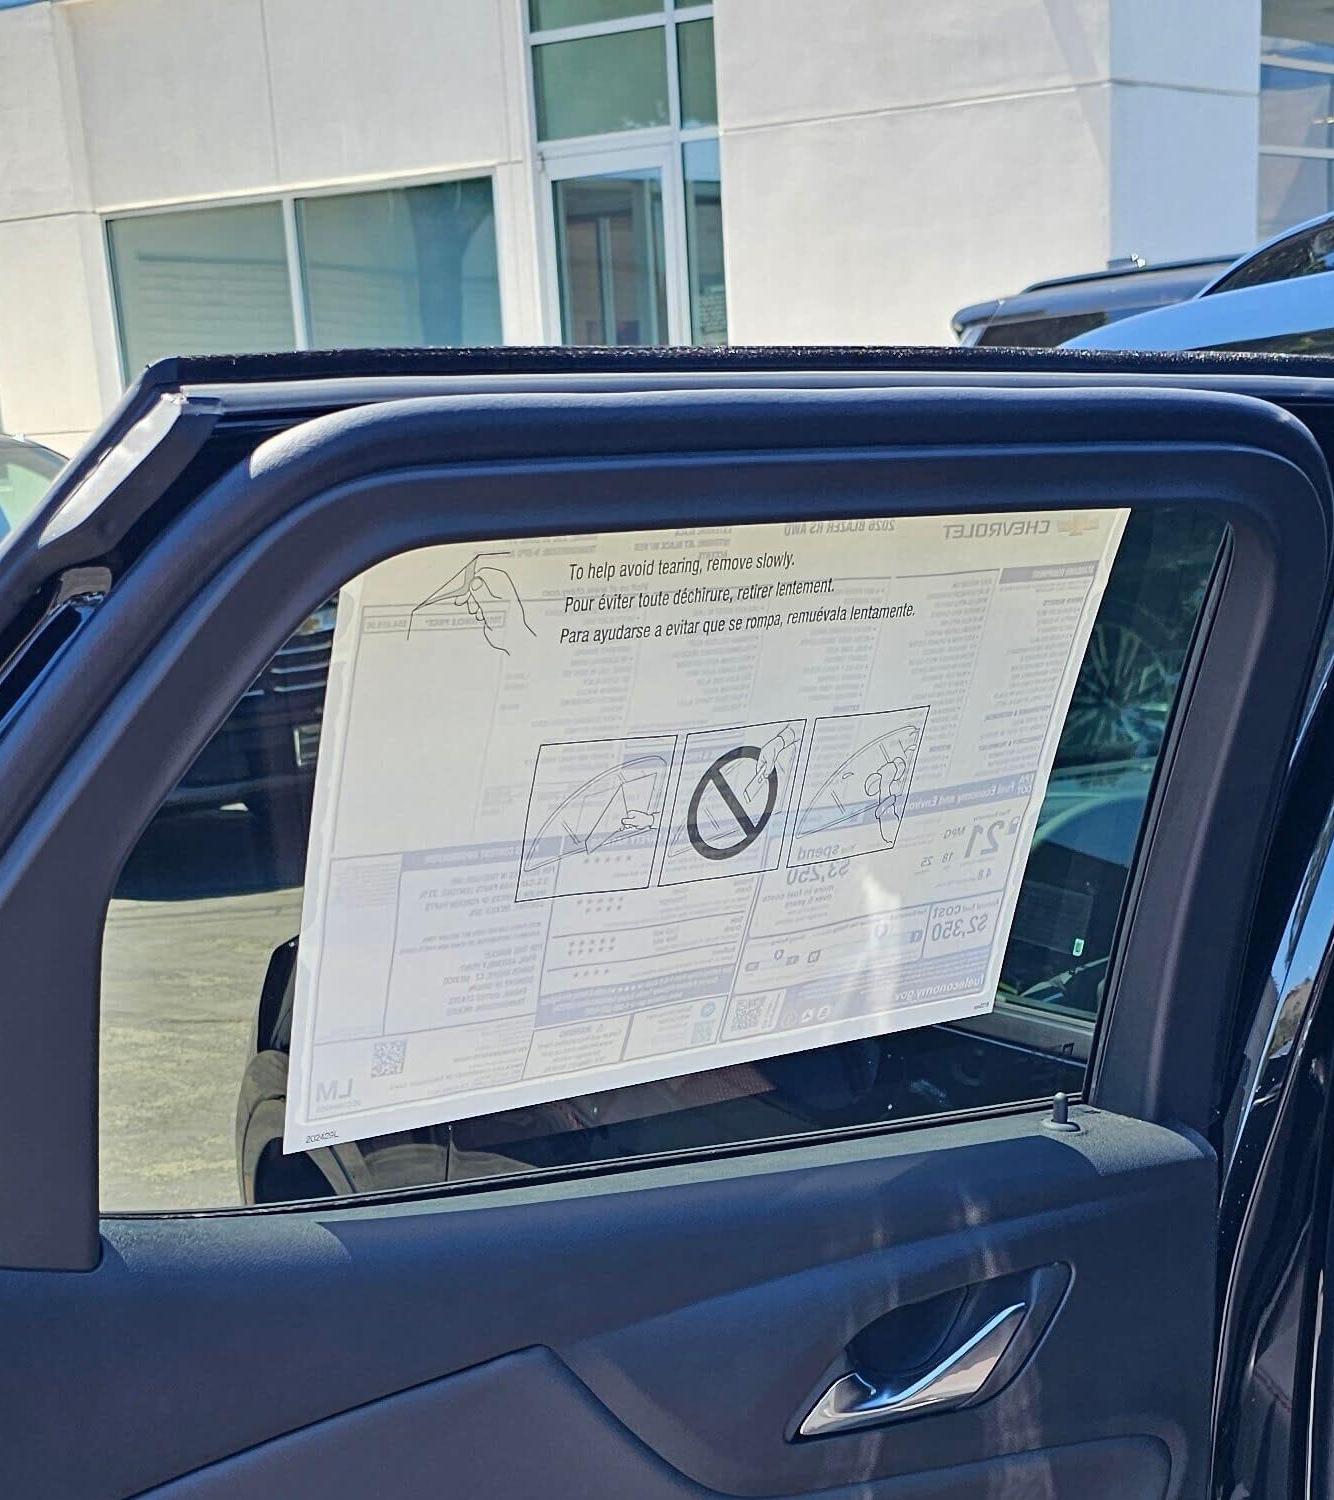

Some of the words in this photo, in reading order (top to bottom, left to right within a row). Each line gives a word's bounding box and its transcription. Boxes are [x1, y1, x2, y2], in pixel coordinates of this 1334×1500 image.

[569, 562, 584, 580] To
[587, 562, 615, 581] help
[619, 559, 654, 577] avoid
[658, 557, 703, 576] tearing,
[706, 556, 753, 572] remove
[756, 551, 795, 570] slowly.
[564, 596, 593, 613] Pour
[598, 592, 635, 610] éviter
[638, 591, 670, 608] toute
[673, 586, 733, 605] déchirure,
[736, 583, 774, 601] retirer
[775, 577, 835, 597] lentement.
[559, 627, 589, 644] Para
[593, 624, 651, 645] ayudarse
[654, 625, 662, 637] a
[666, 618, 700, 637] evitar
[702, 619, 725, 636] que
[728, 618, 743, 631] se
[745, 613, 784, 630] rompa,
[786, 605, 847, 625] remuévala
[849, 602, 916, 621] lentamente.
